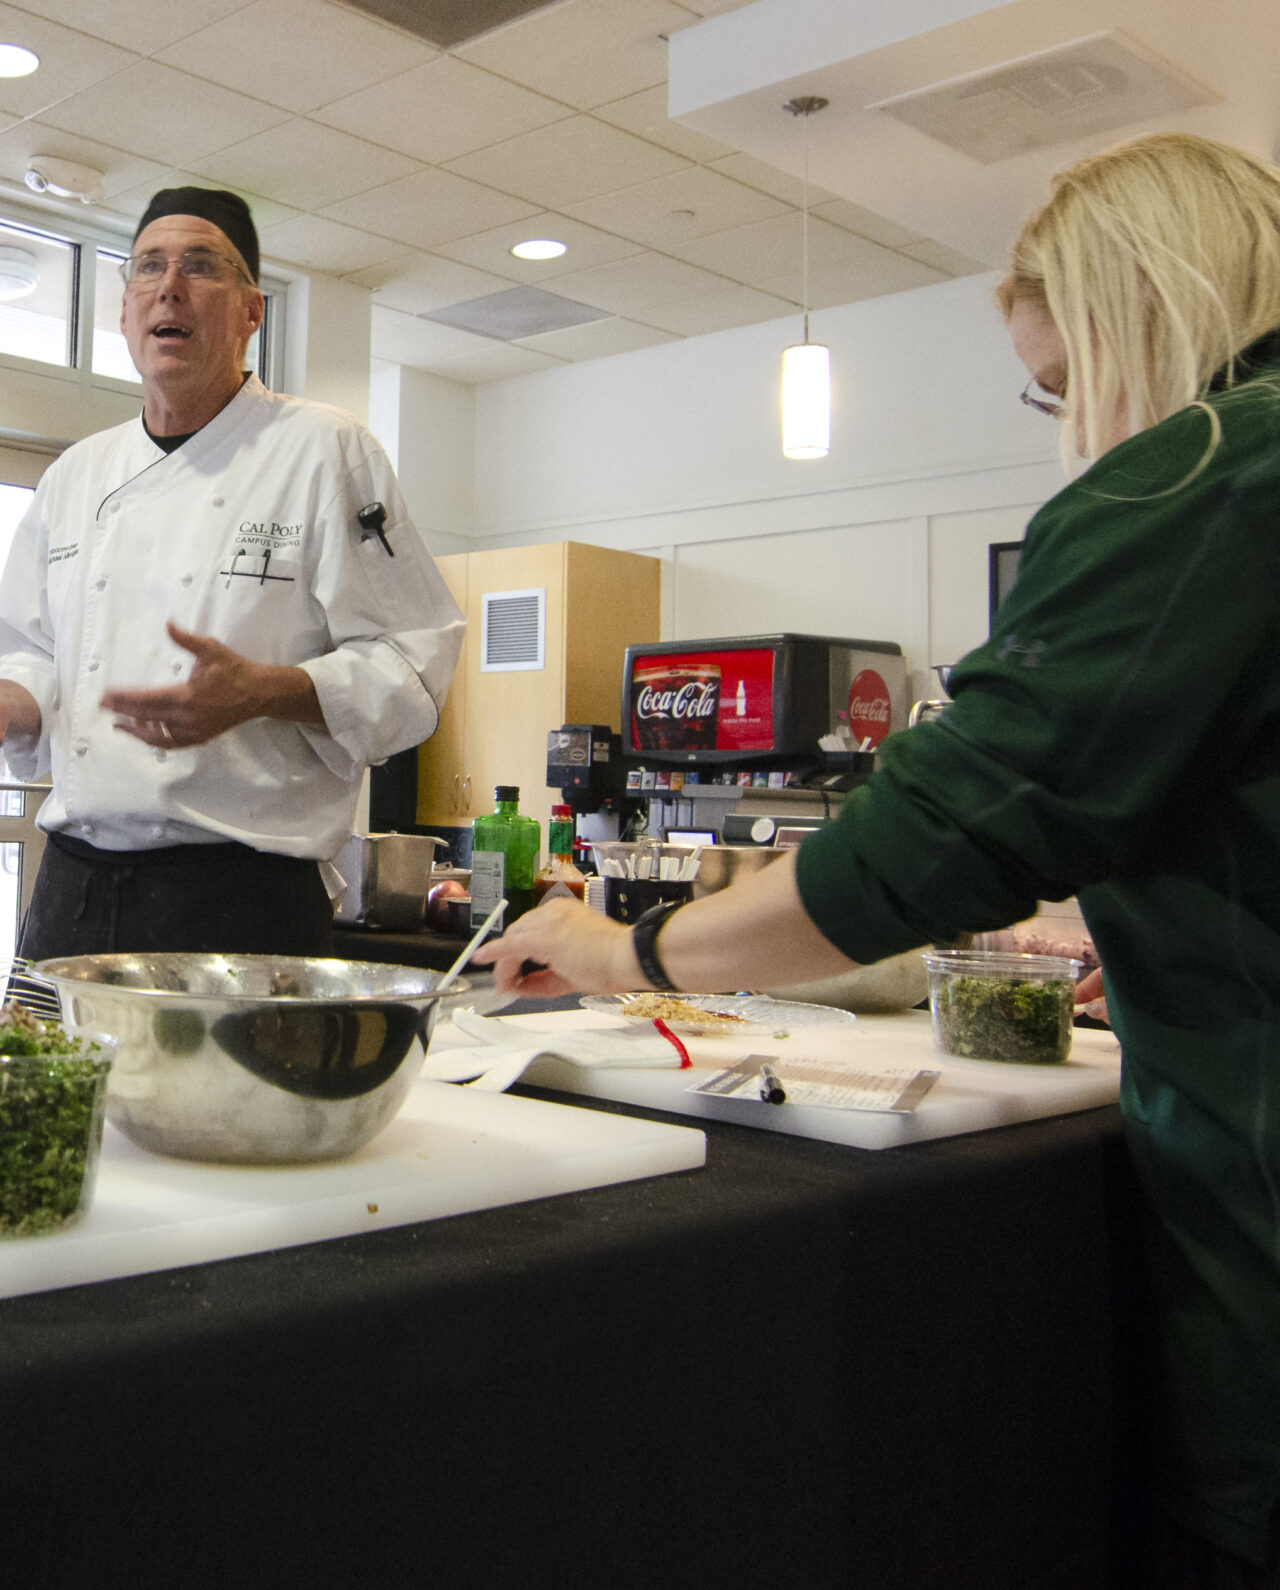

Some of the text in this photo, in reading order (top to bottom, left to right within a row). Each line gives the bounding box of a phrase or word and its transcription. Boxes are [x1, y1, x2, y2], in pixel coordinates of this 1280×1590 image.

[239, 521, 303, 537] CAL POLY
[235, 536, 271, 547] CAMPUS
[637, 681, 719, 719] Coca-Cola
